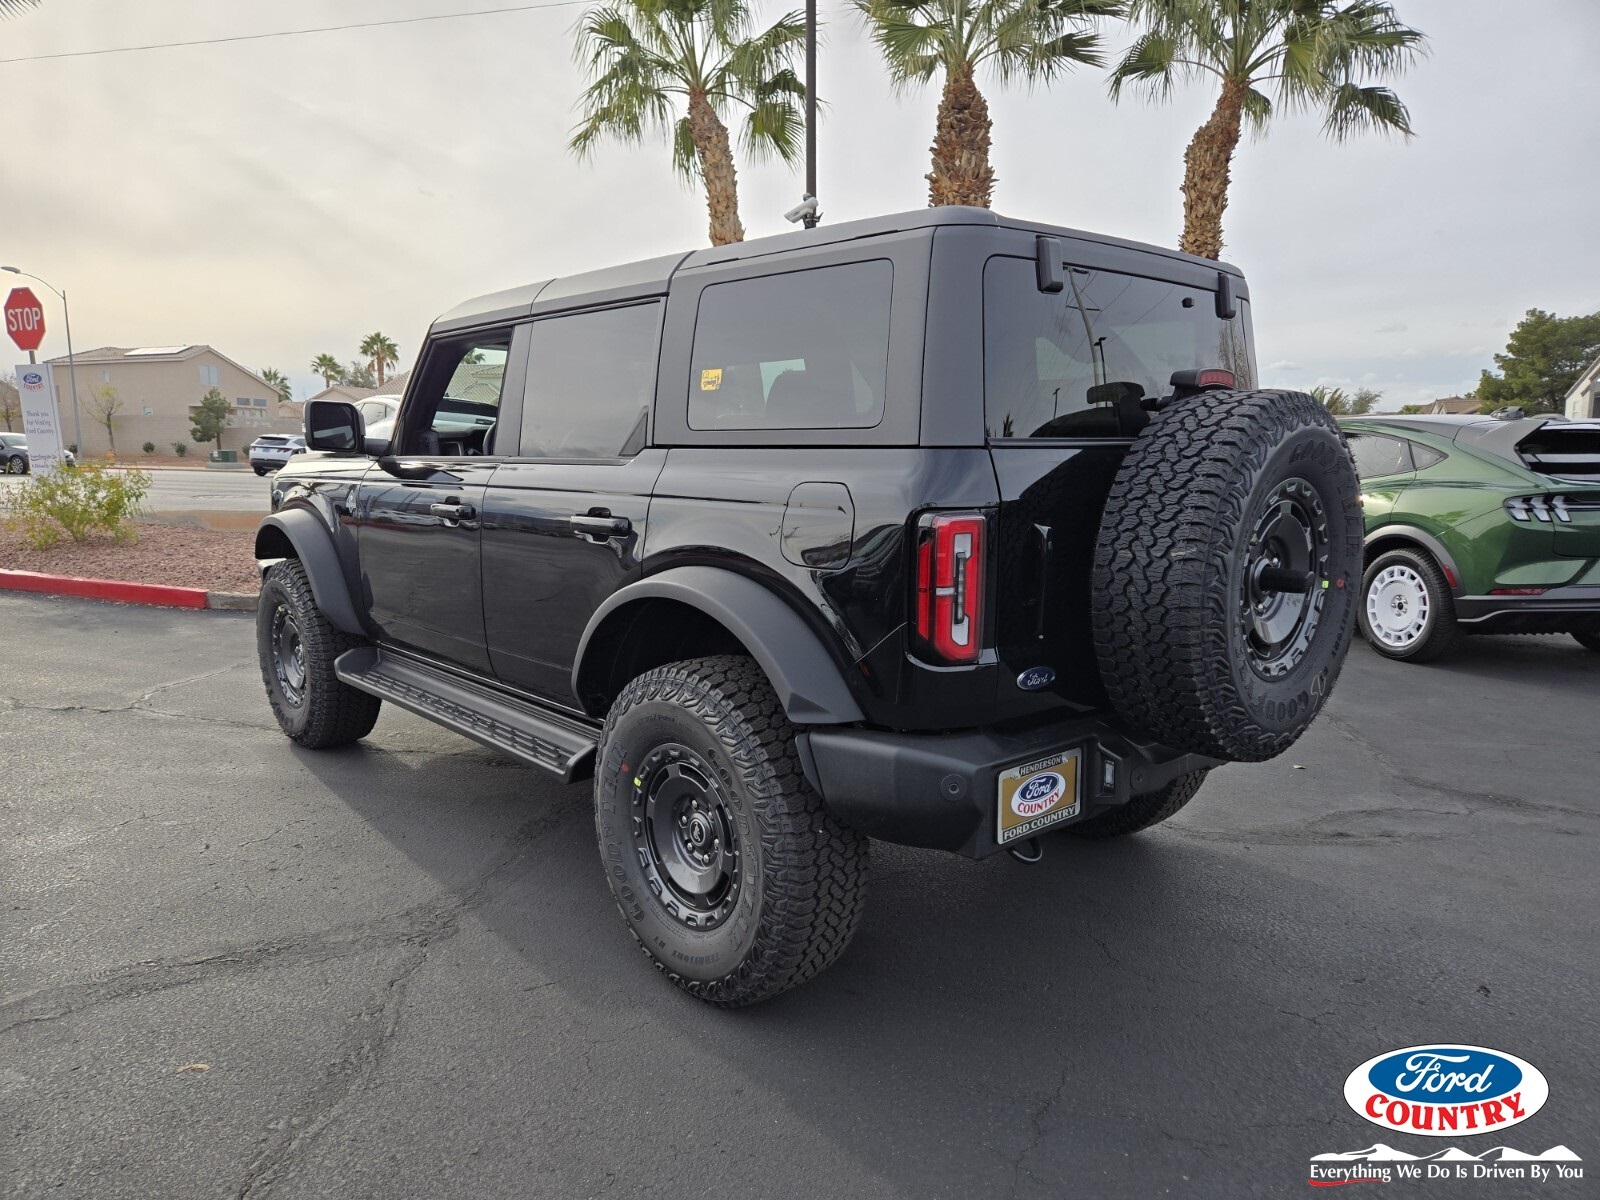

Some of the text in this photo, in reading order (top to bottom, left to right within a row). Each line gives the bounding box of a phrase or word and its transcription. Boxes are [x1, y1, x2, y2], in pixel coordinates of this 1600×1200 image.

[8, 307, 41, 332] STOP
[1027, 672, 1048, 686] Ford
[1020, 756, 1062, 776] HENDERSON
[1025, 777, 1052, 799] Ford
[1017, 791, 1060, 814] COUNTRY
[1004, 807, 1075, 840] FORD COUNTRY
